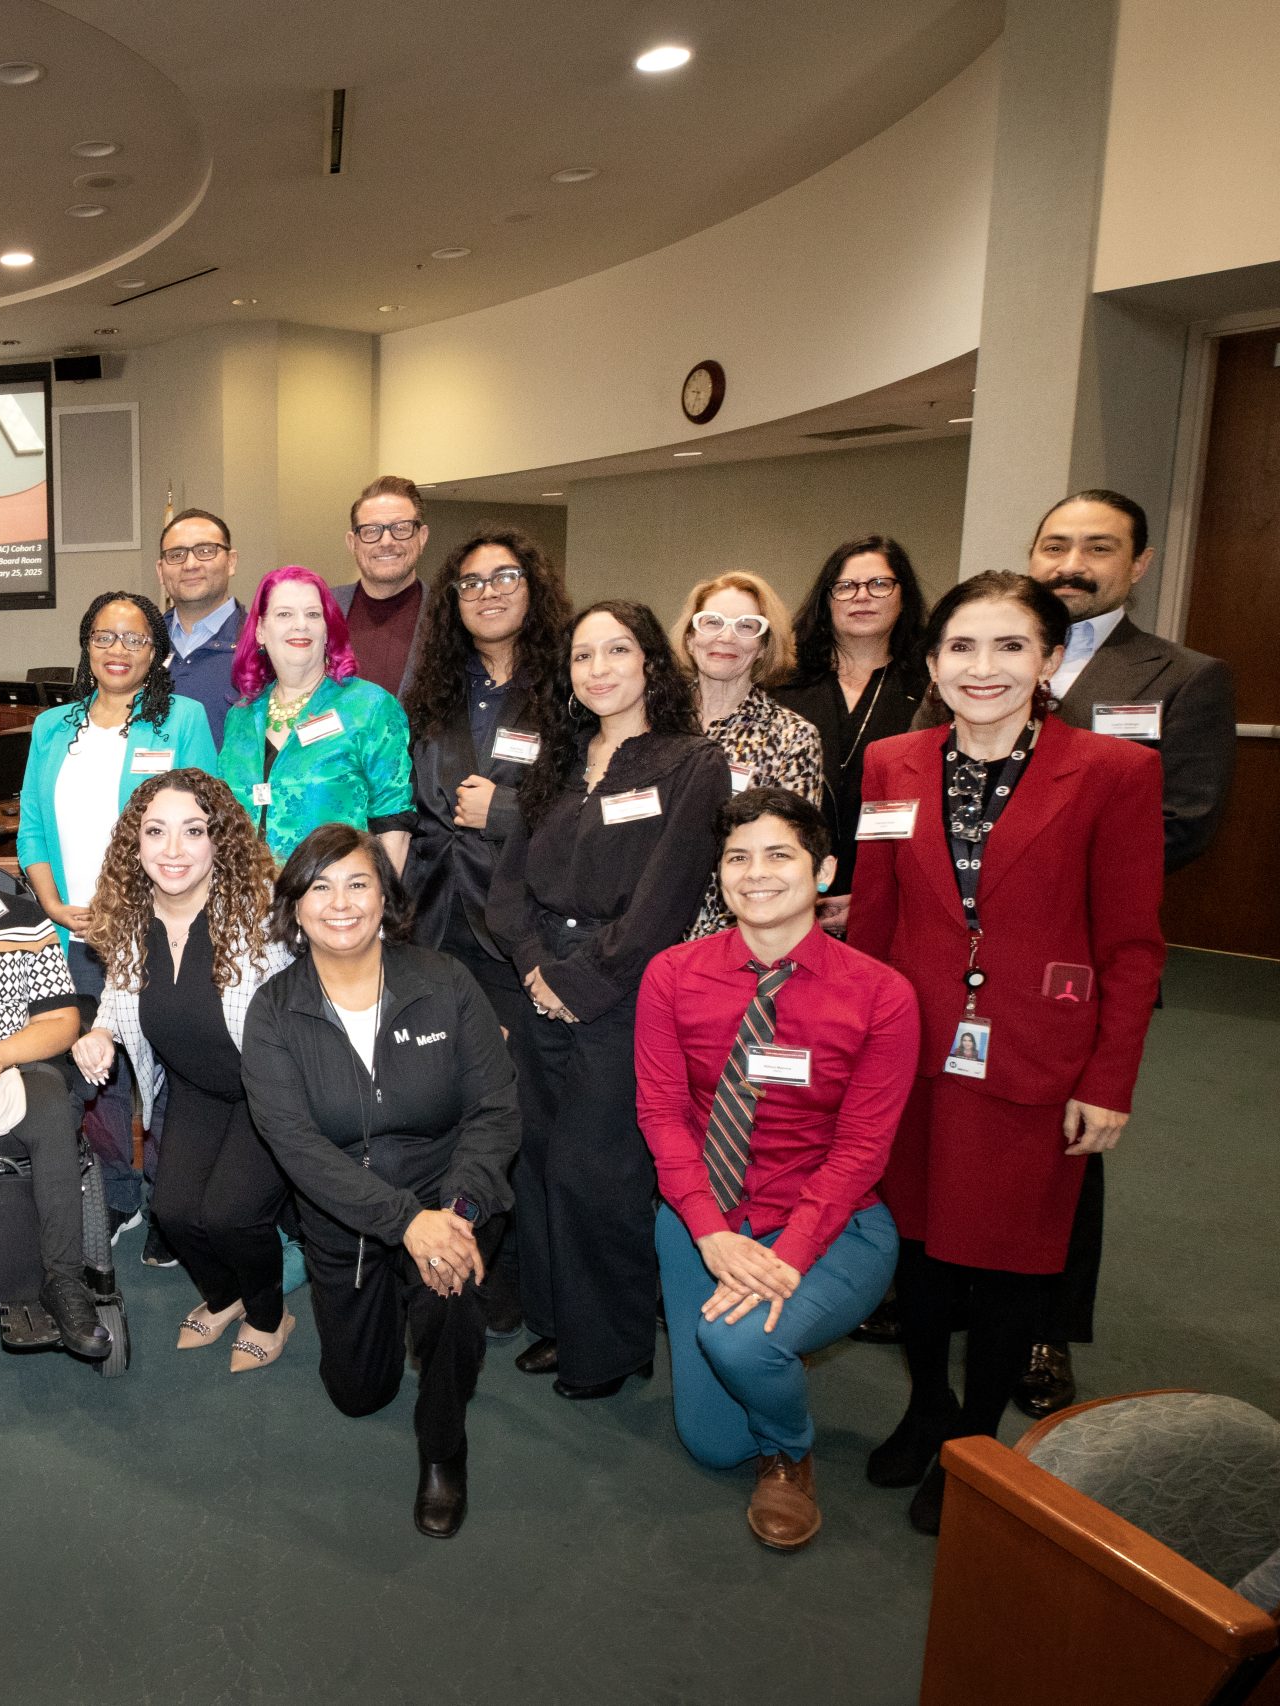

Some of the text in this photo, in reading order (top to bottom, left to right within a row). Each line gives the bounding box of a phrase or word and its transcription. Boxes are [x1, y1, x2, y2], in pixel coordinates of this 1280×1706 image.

[11, 544, 35, 553] Cohort
[11, 569, 22, 577] 25,
[23, 568, 43, 576] 2025
[394, 1028, 448, 1046] M Metro
